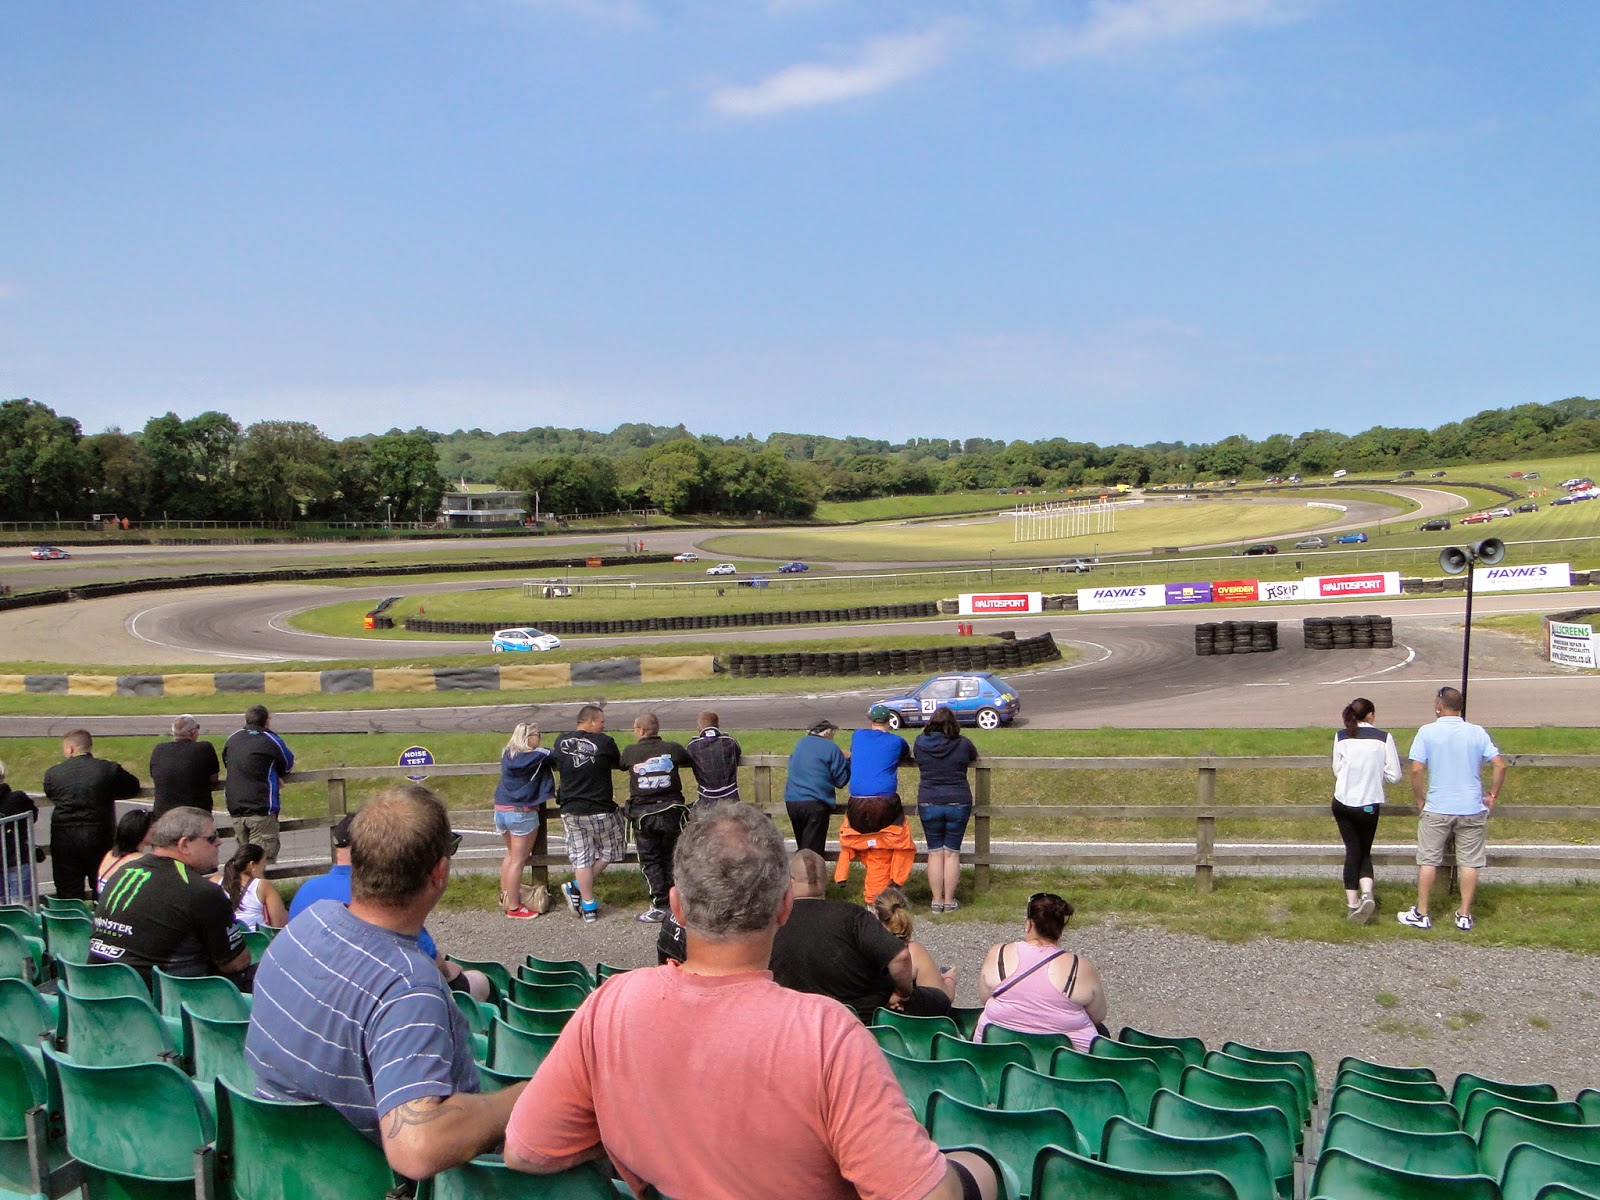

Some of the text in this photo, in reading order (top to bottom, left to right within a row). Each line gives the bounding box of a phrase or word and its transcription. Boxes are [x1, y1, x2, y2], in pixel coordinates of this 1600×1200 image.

[1487, 567, 1547, 578] HAYNES
[1093, 588, 1146, 598] HAYNES
[924, 701, 934, 710] 21
[637, 775, 671, 789] 273
[674, 927, 680, 941] 2
